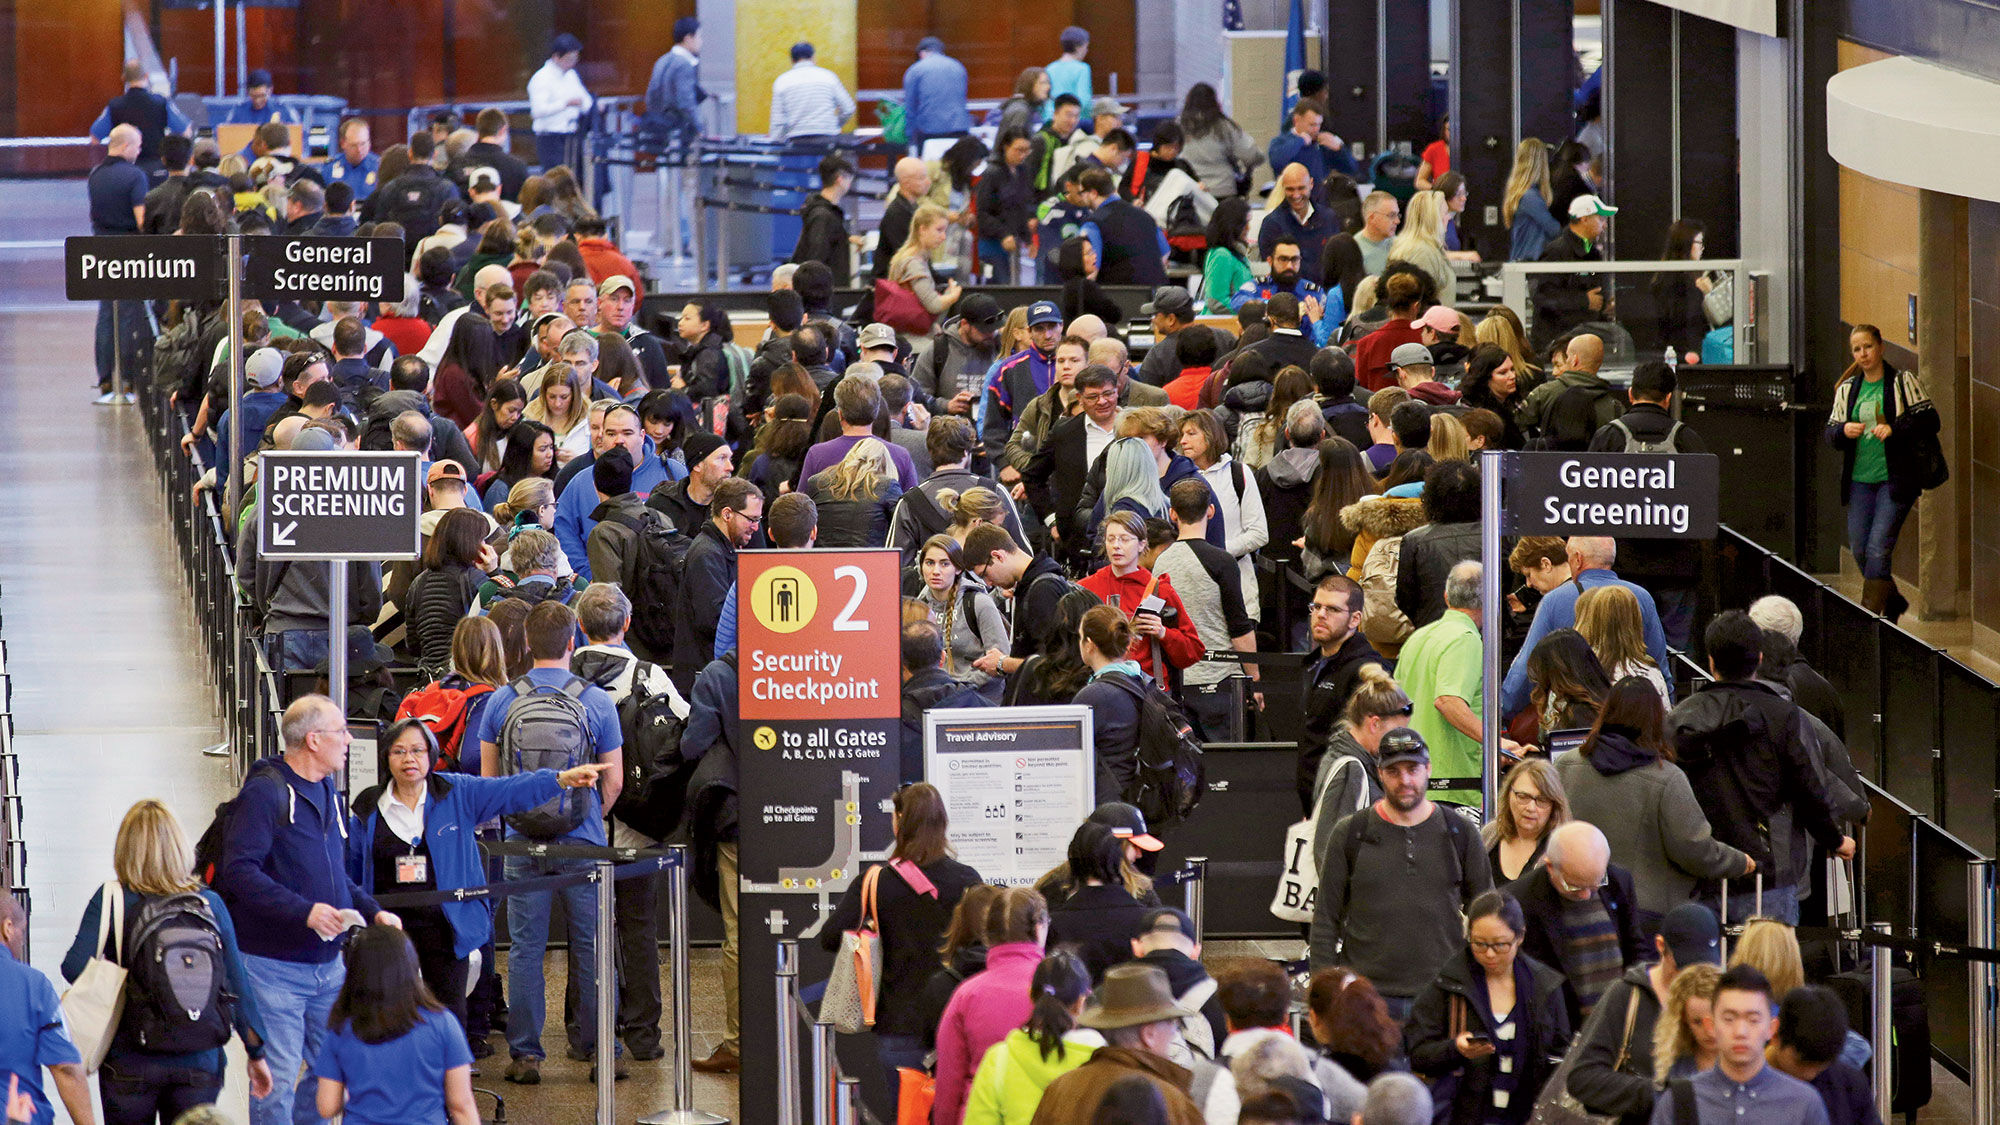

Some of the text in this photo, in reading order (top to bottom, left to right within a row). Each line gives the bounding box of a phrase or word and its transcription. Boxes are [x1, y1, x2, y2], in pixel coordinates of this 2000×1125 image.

[285, 241, 372, 265] General
[81, 253, 196, 279] Premium
[274, 268, 383, 298] Screening
[273, 466, 405, 491] PREMIUM
[1559, 459, 1676, 489] General
[271, 494, 405, 516] SCREENING
[1543, 496, 1689, 534] Screening
[832, 565, 870, 632] 2
[751, 649, 843, 677] Security
[751, 677, 879, 705] Checkpoint
[782, 727, 887, 747] to all Gates
[945, 732, 1018, 743] Travel Advisory
[782, 748, 880, 760] A, B, C, D, N & S Gates
[763, 804, 818, 815] All Checkpoints
[763, 814, 815, 824] go to all Gates
[856, 815, 862, 825] 2
[1288, 837, 1308, 875] I
[792, 879, 799, 889] 5
[815, 878, 823, 889] 4
[841, 868, 848, 879] 3
[985, 876, 1036, 886] afety is our
